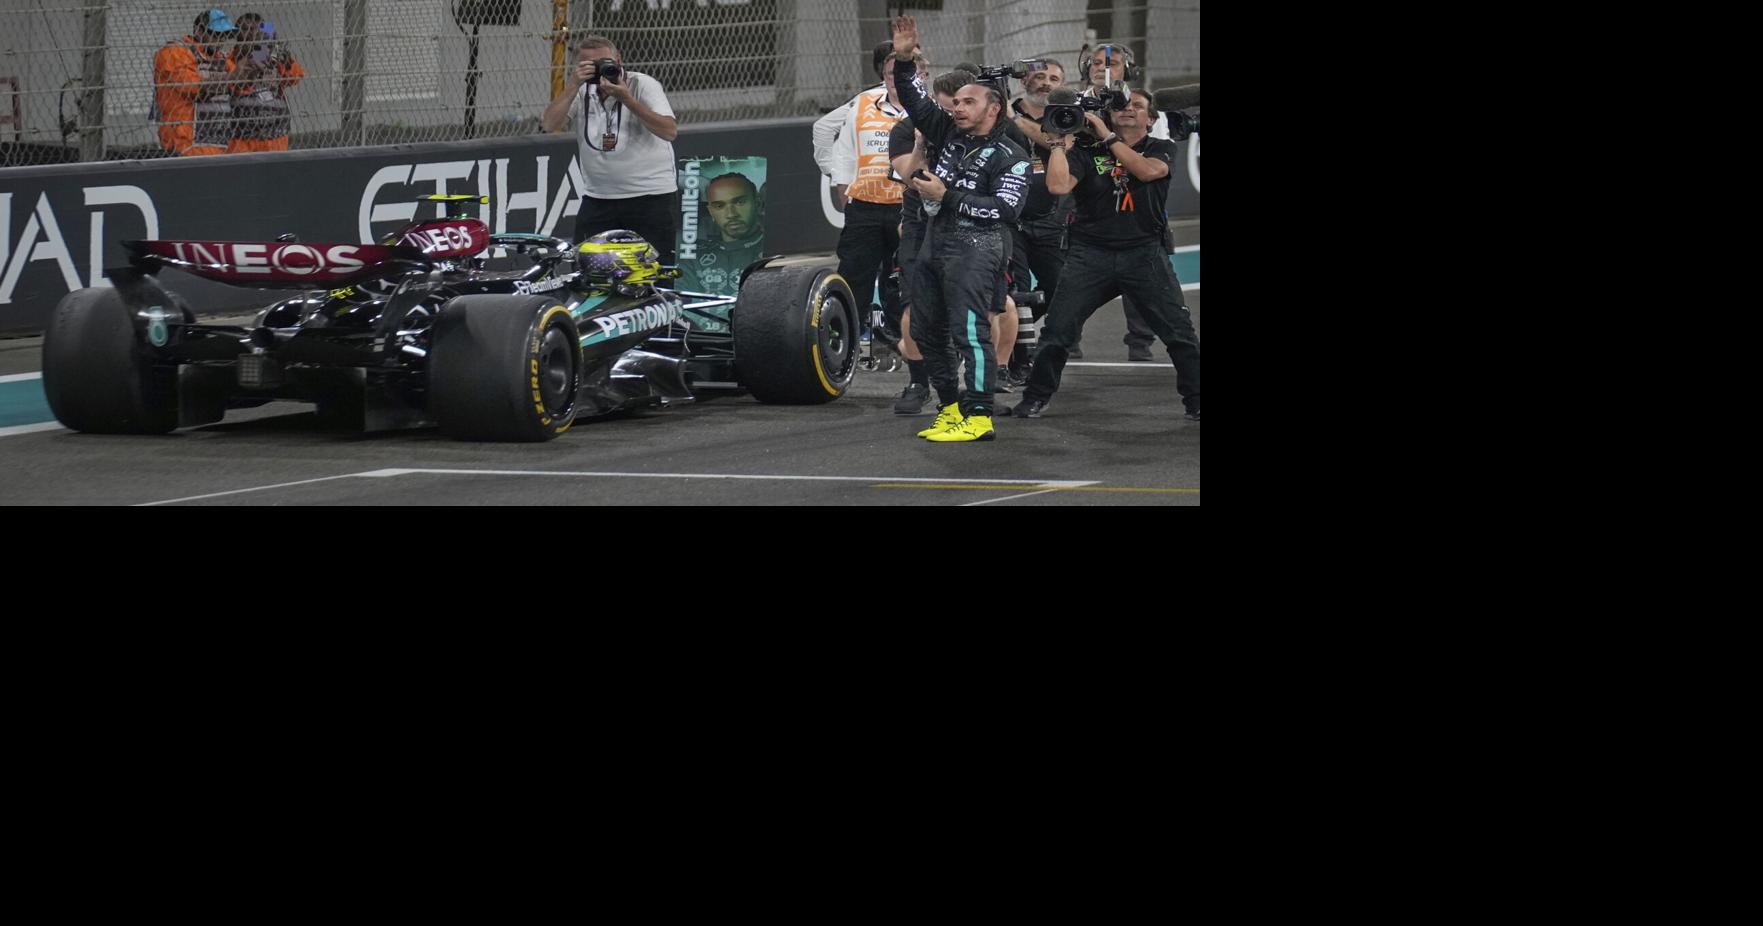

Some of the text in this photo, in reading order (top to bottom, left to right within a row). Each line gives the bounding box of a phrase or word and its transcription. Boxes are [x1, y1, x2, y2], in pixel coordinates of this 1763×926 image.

[1002, 182, 1020, 191] IWC
[358, 155, 585, 259] ETIHA
[680, 161, 700, 260] Hamilton
[958, 202, 1001, 220] INEOS
[0, 185, 160, 304] AD
[404, 225, 473, 253] INEOS
[171, 242, 366, 275] INEOS
[872, 310, 885, 327] IWC
[530, 359, 545, 414] ZERO
